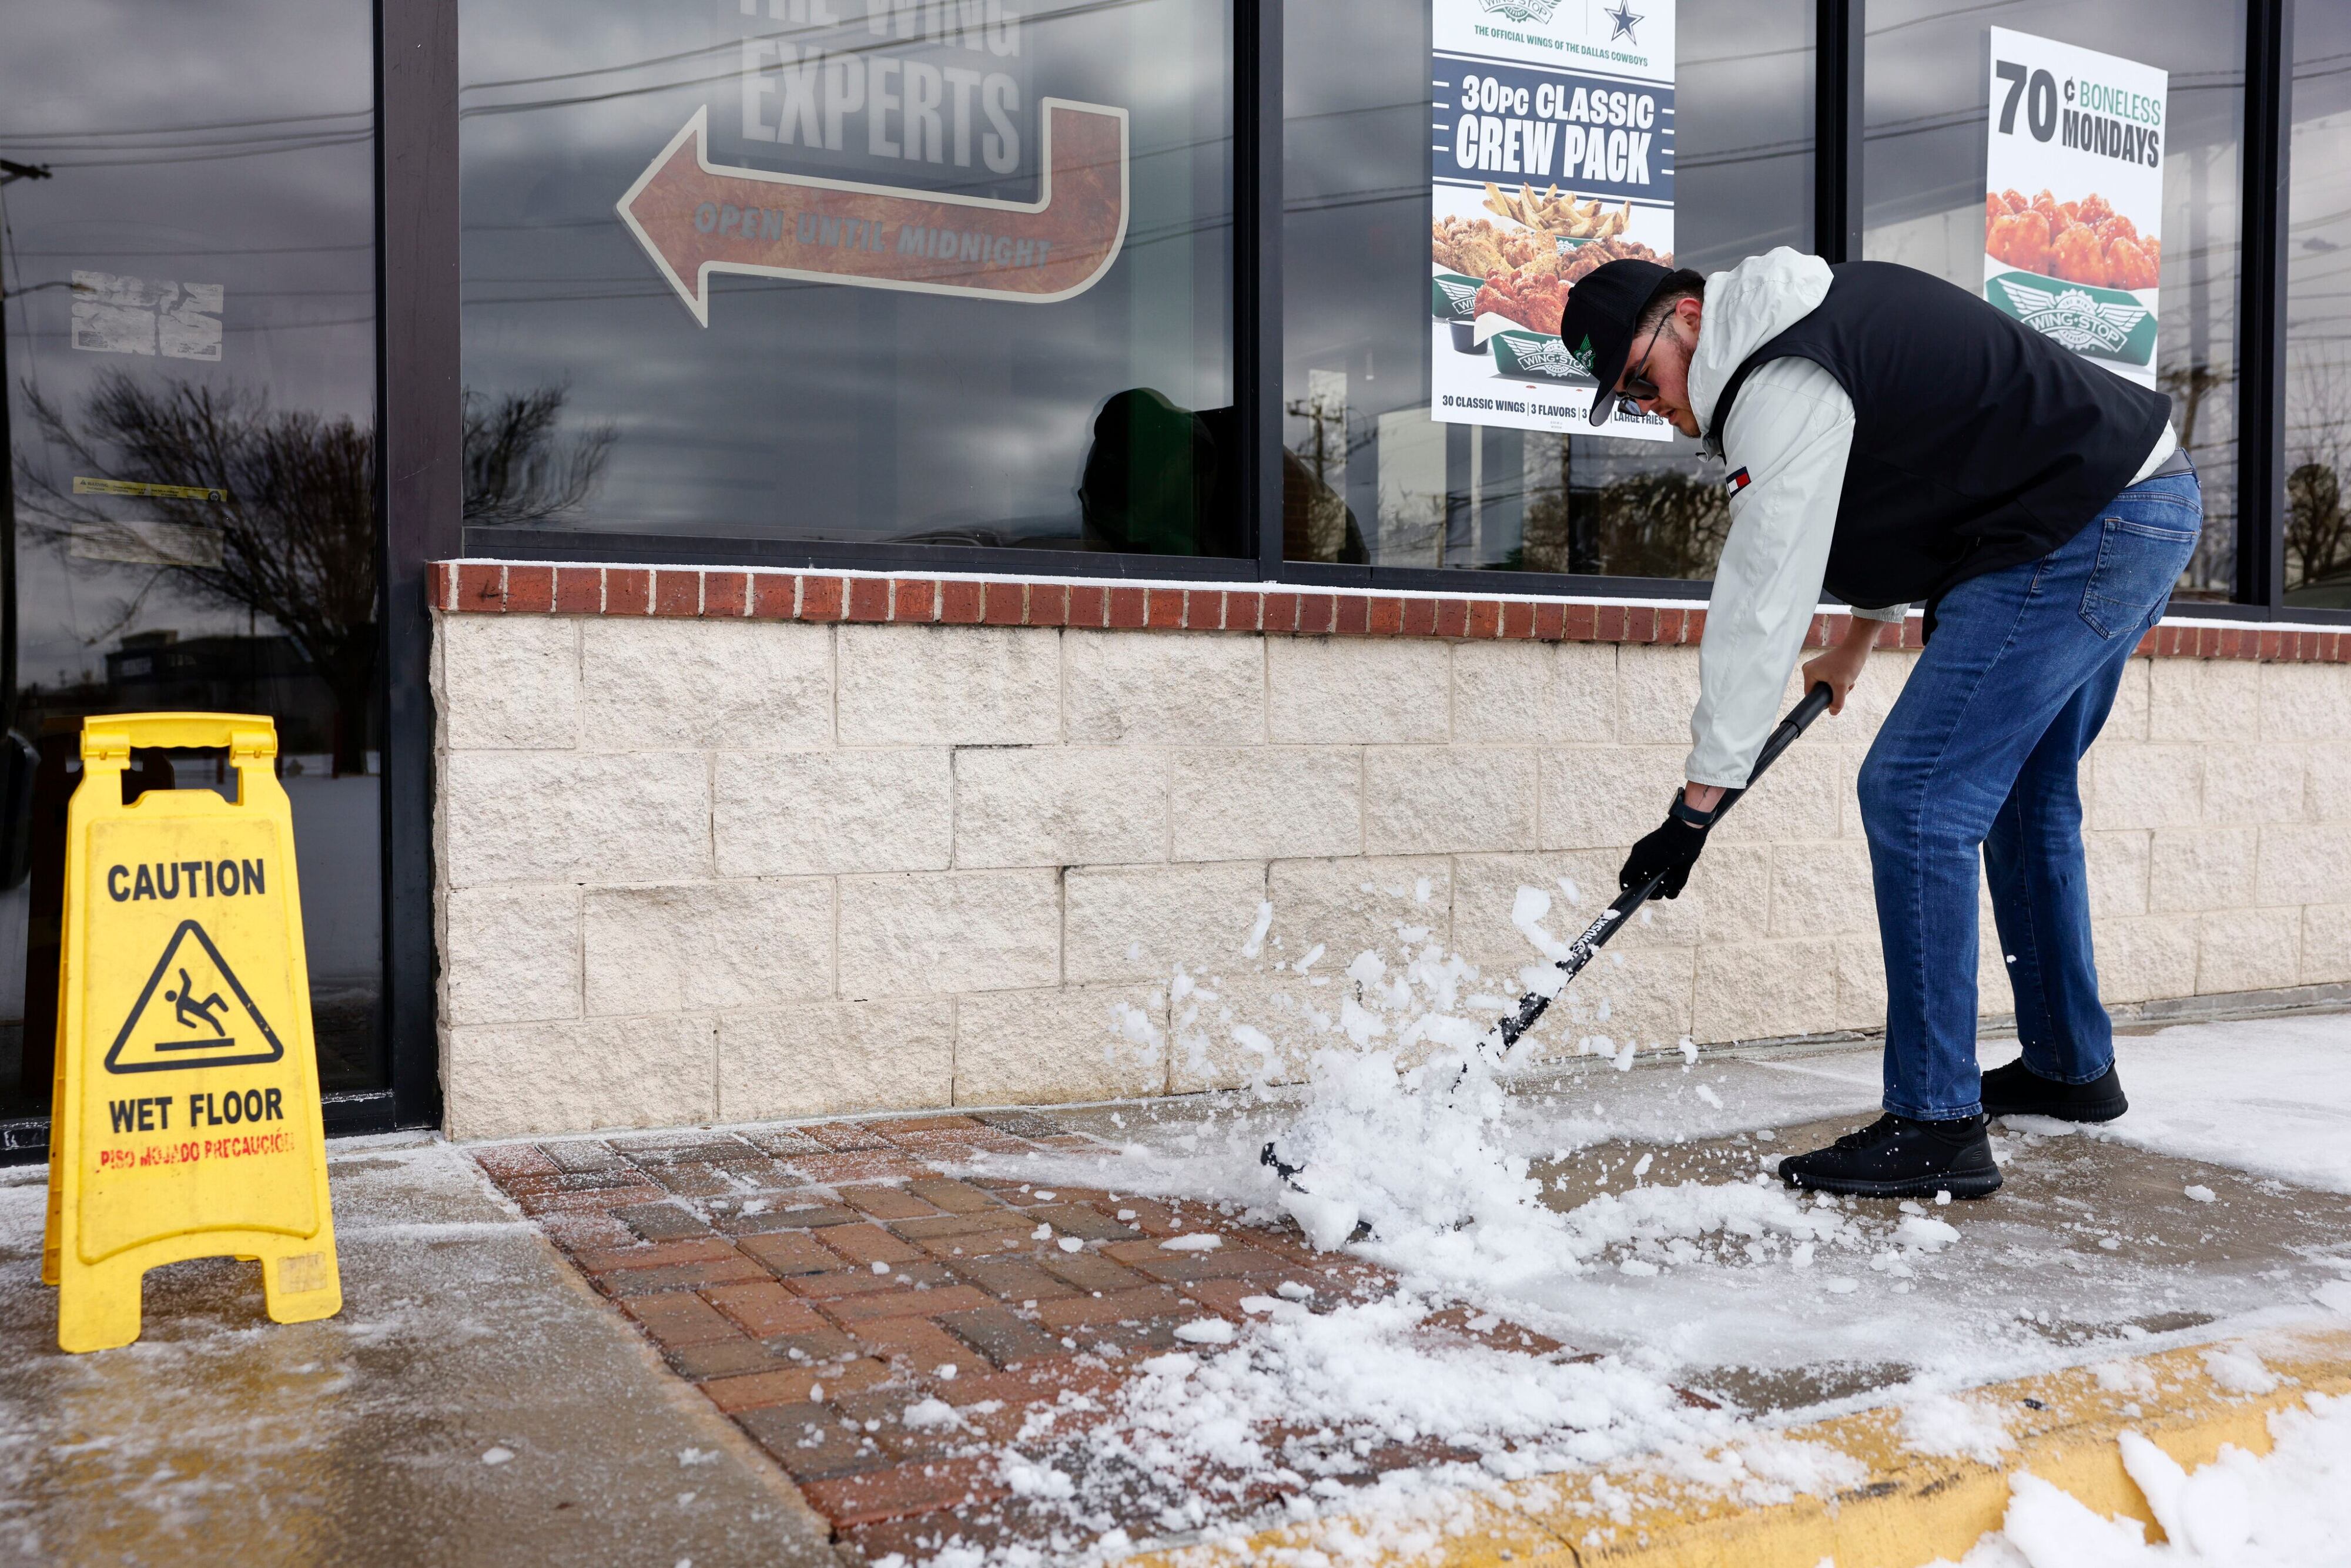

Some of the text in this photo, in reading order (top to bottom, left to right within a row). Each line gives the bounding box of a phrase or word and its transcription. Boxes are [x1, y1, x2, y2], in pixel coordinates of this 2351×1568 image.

[1475, 25, 1648, 66] THE OFFICIAL WINGS OF THE DALLAS COWBOYS
[742, 36, 1020, 174] EXPERTS
[1536, 83, 1655, 129] CLASSIC
[2079, 80, 2161, 126] BONELESS
[1456, 114, 1653, 185] CREW PACK
[2062, 108, 2159, 168] MONDAYS
[694, 202, 1053, 269] OPEN UNTIL MIDNIGHT
[1442, 395, 1454, 406] 30
[1455, 396, 1493, 410] CLASSIC
[1495, 400, 1525, 413] WINGS
[1531, 404, 1536, 414] 3
[1538, 404, 1576, 418] FLAVORS
[1582, 408, 1587, 419] 3
[1614, 411, 1640, 424] LARGE
[1642, 414, 1664, 425] FRIES
[108, 859, 265, 902] CAUTION
[1580, 916, 1609, 943] HUSK
[109, 1088, 284, 1133] WET FLOOR
[101, 1149, 135, 1170] PISO
